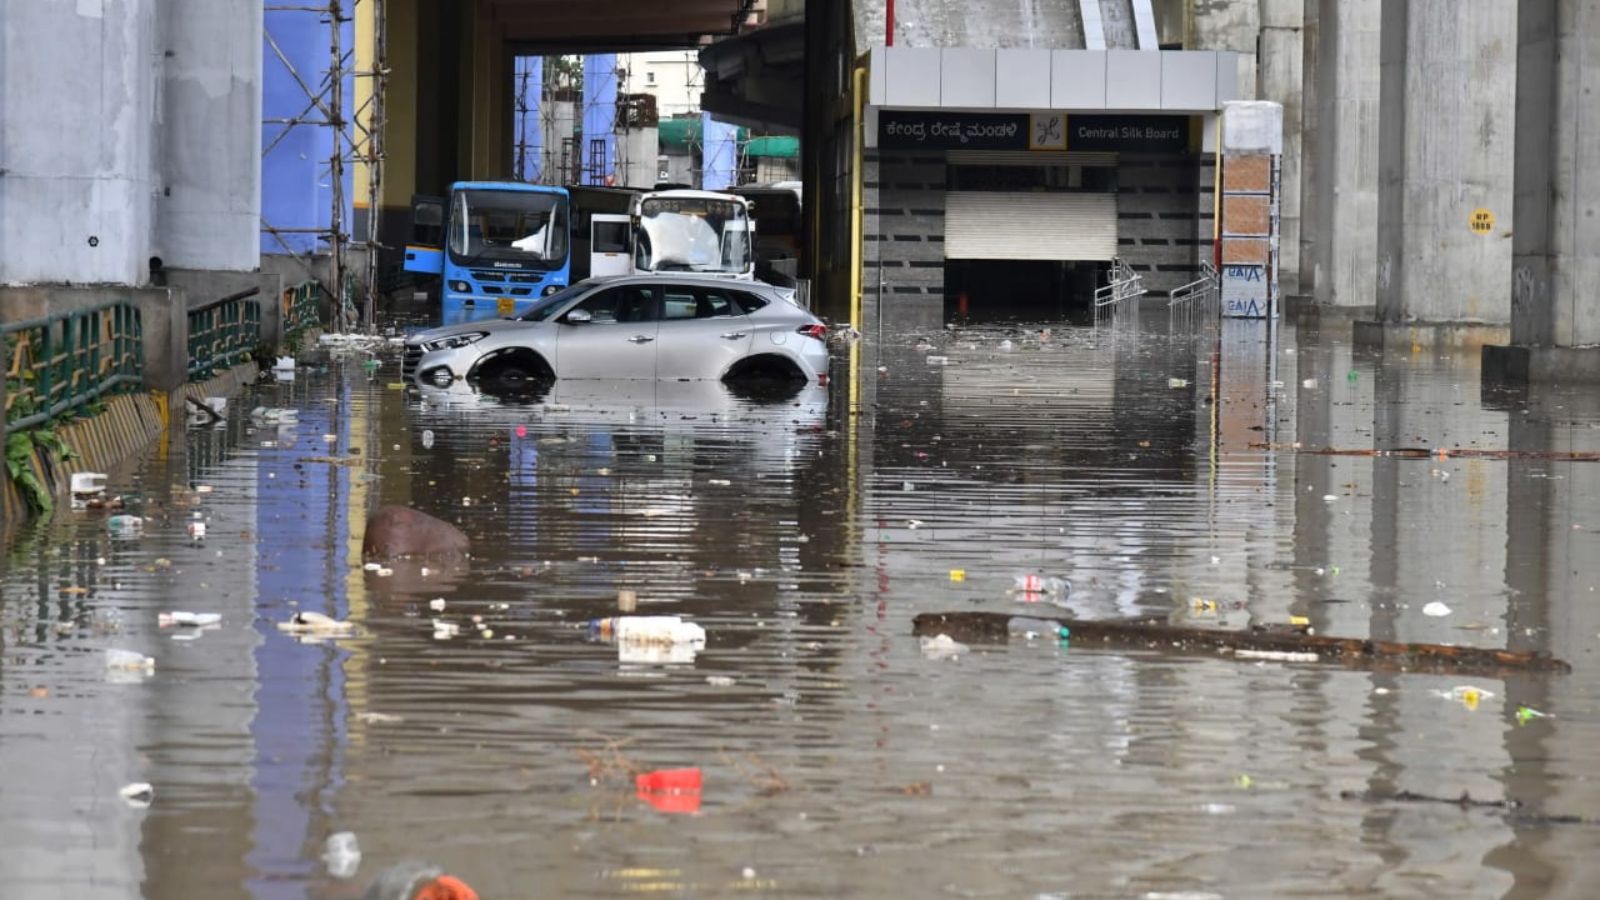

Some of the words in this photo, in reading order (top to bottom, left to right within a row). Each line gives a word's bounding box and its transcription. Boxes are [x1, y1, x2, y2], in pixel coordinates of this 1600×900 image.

[1078, 126, 1119, 138] Central
[1121, 127, 1142, 138] Silk
[1145, 127, 1180, 138] Board
